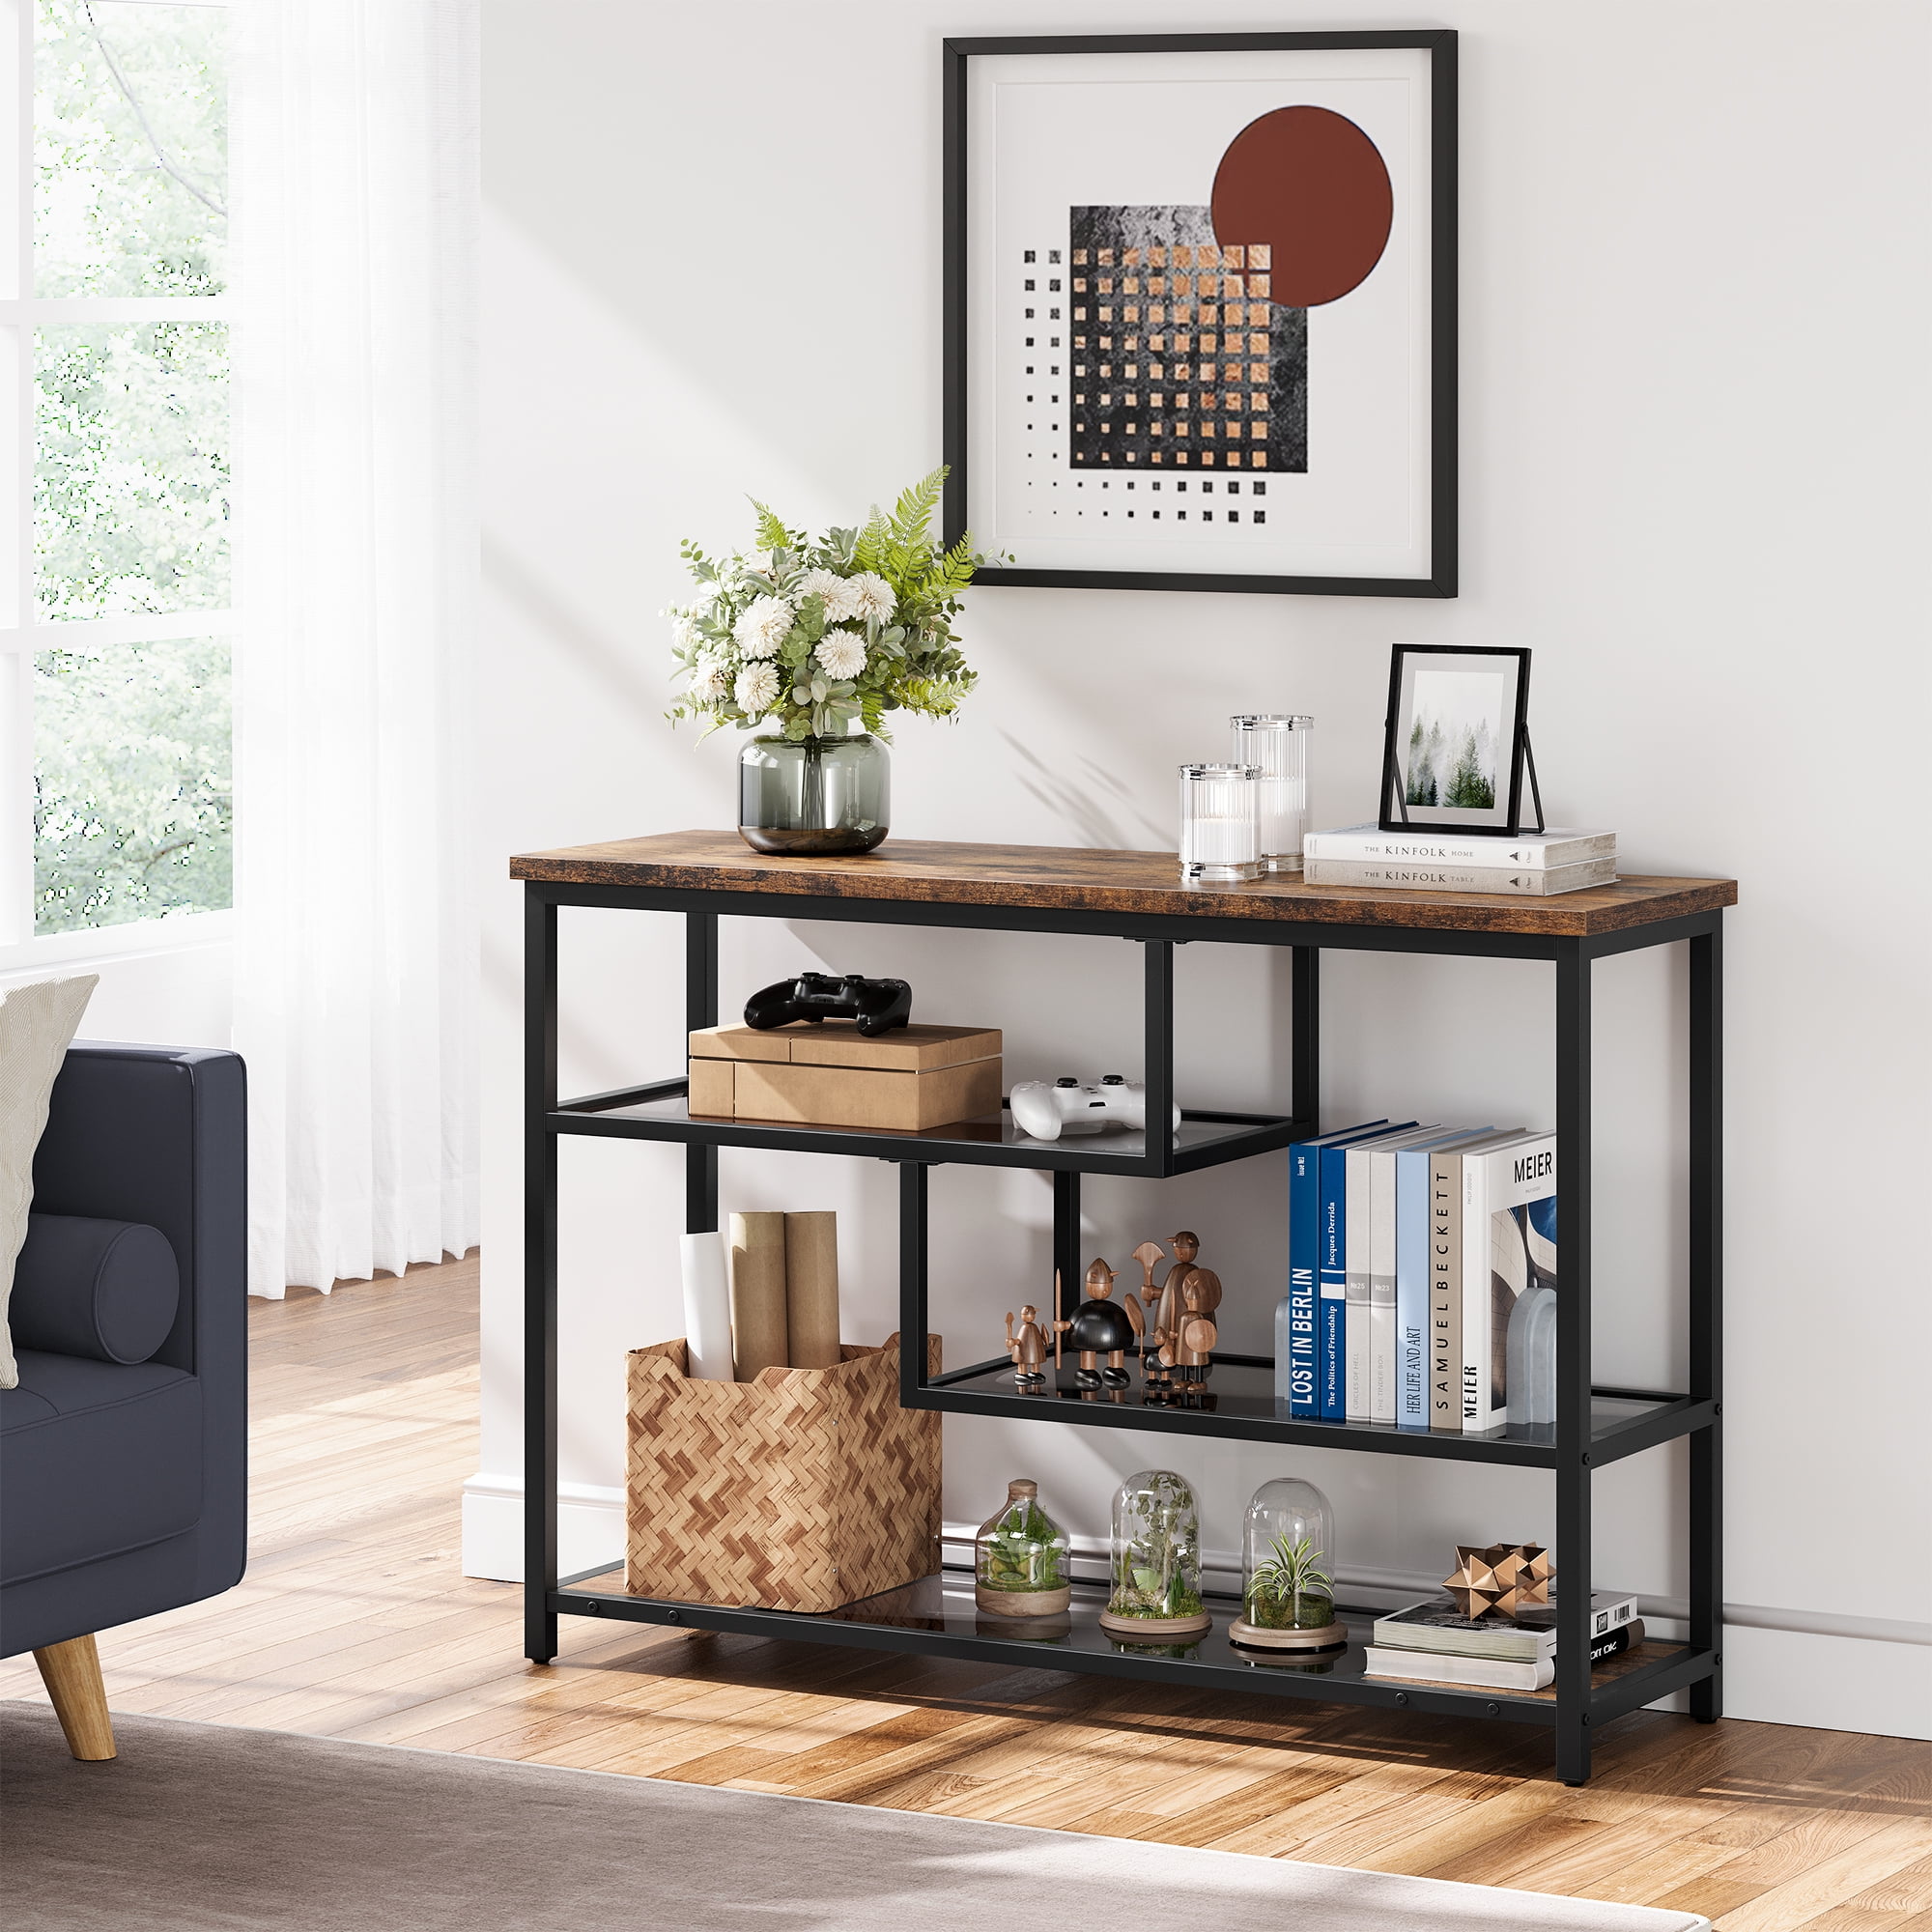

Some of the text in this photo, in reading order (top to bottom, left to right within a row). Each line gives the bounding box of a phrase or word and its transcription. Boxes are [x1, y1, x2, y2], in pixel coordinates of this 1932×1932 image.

[1385, 845, 1446, 857] KINFOLK
[1385, 871, 1446, 883] KINFOLK
[1514, 1151, 1552, 1183] MEIER
[1327, 1235, 1338, 1265] Jacques
[1435, 1173, 1449, 1409] SAMUEL BECKETT
[1292, 1267, 1313, 1405] LOST IN BERLIN
[1327, 1305, 1338, 1350] Friendship
[1327, 1350, 1335, 1360] of
[1406, 1325, 1421, 1414] HER LIFE AND ART
[1353, 1371, 1359, 1381] OF
[1463, 1365, 1477, 1419] MEIER
